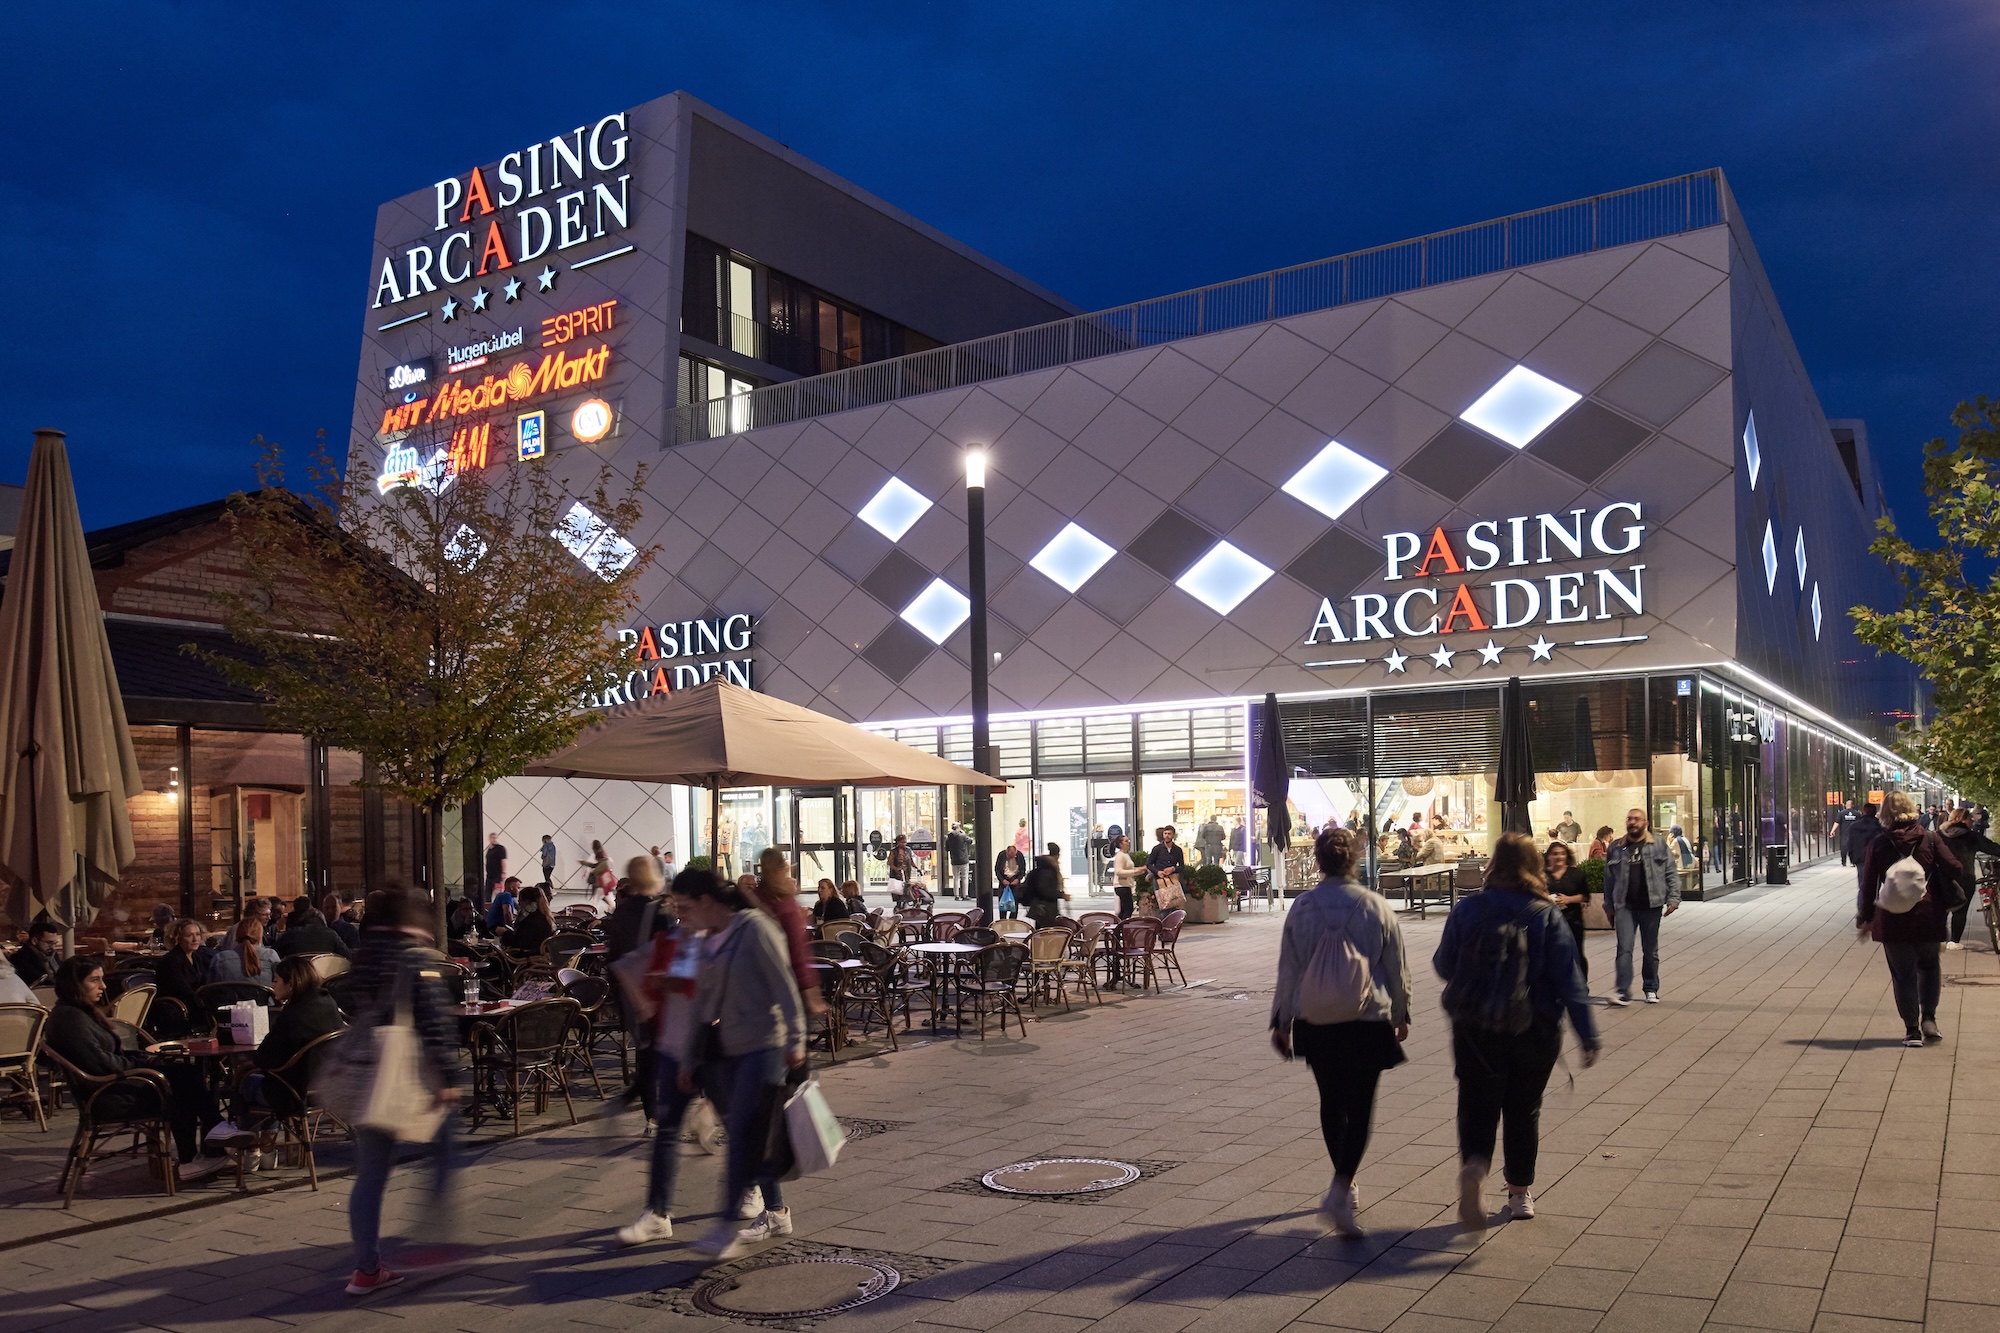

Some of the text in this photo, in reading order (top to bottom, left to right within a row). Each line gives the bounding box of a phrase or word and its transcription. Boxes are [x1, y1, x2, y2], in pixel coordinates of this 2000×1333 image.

[434, 111, 630, 231] PASING
[371, 173, 632, 310] ARCADEN
[447, 326, 523, 364] Hugendubel
[541, 299, 618, 348] ESPRIT
[381, 398, 428, 435] HIT
[386, 445, 416, 474] dm
[522, 436, 541, 449] ALDI
[1382, 501, 1646, 582] PASING
[1303, 563, 1647, 646] ARCADEN
[617, 613, 752, 662] PASING
[1680, 680, 1687, 689] 5
